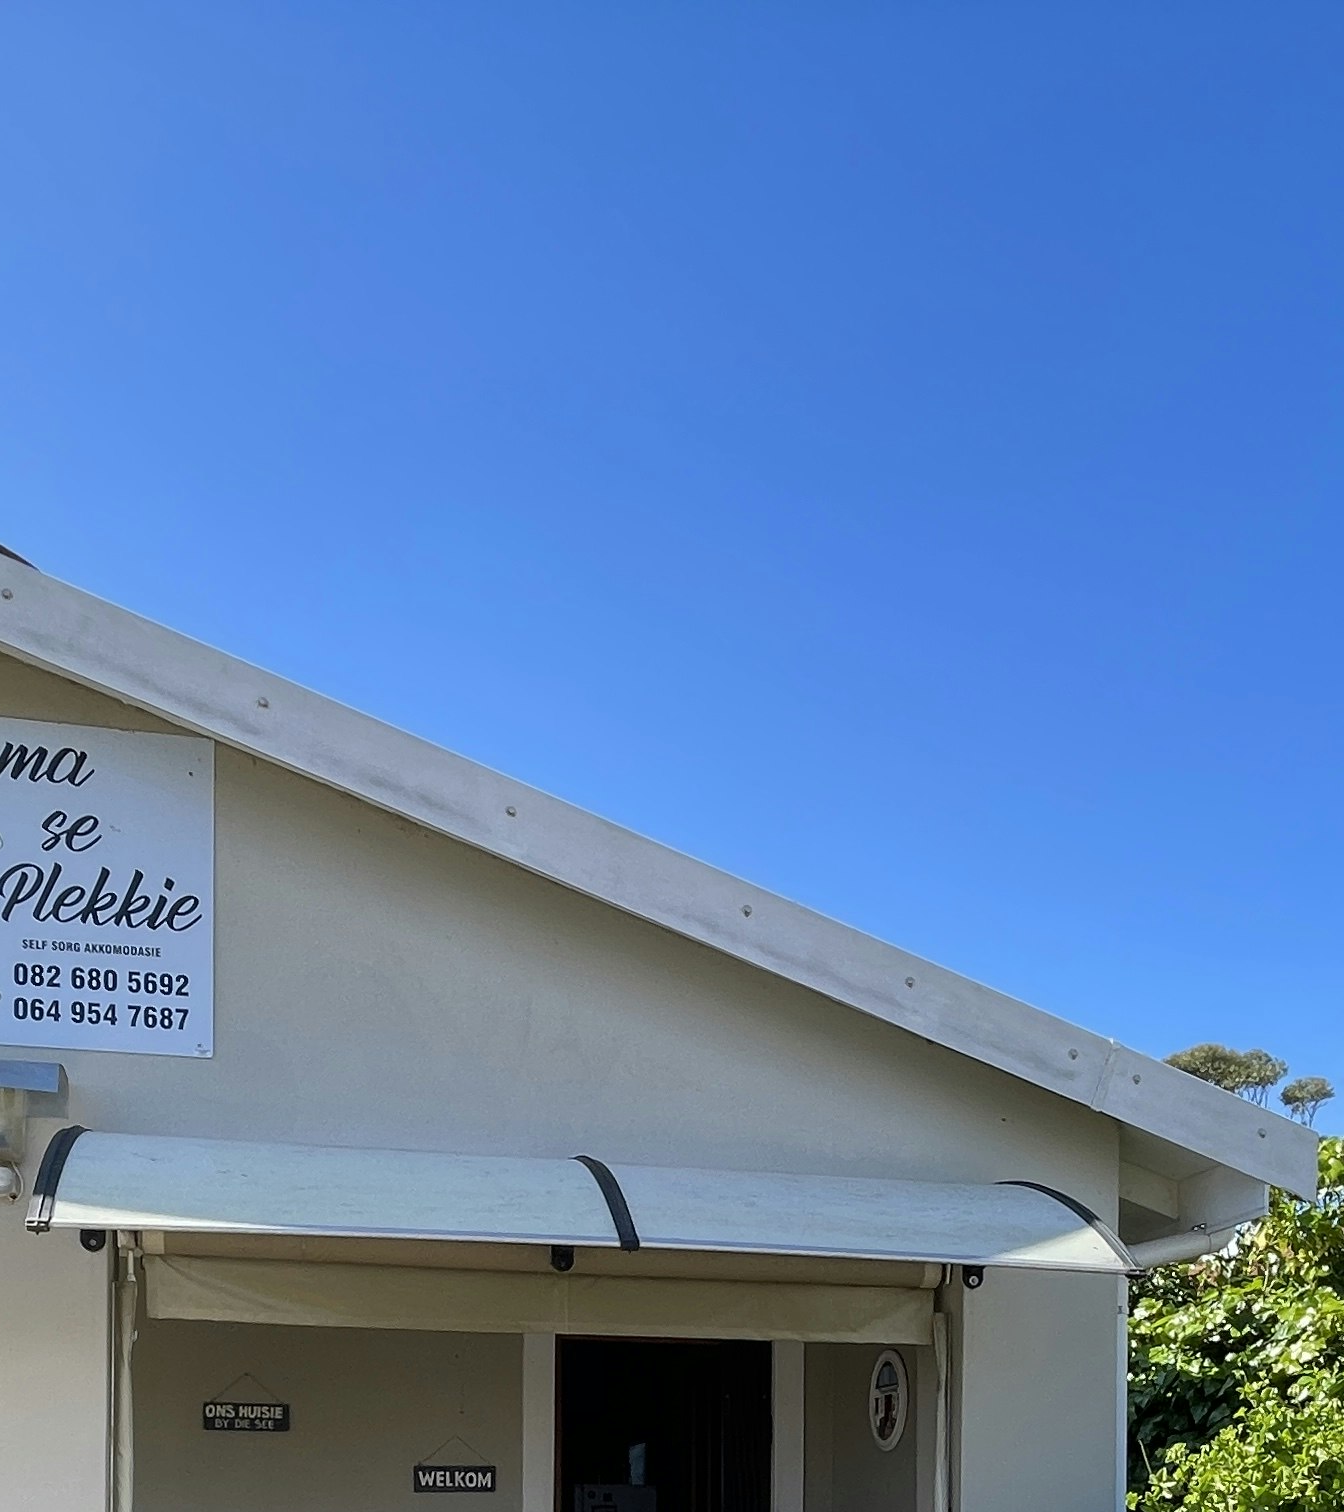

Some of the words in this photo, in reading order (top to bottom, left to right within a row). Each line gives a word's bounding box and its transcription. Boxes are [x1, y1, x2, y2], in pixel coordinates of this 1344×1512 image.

[41, 810, 102, 852] se
[22, 939, 47, 950] SELF
[51, 941, 81, 952] SORG
[84, 943, 162, 957] AKKOMODASIE
[14, 963, 61, 987] 082
[71, 967, 118, 991] 680
[127, 971, 189, 996] 5692
[14, 997, 61, 1022] 064
[71, 1001, 118, 1025] 954
[127, 1005, 189, 1030] 7687
[205, 1404, 235, 1418] ONS
[239, 1405, 283, 1419] HUISIE
[214, 1419, 229, 1428] BY
[235, 1419, 251, 1429] DIE
[418, 1470, 492, 1488] WELKOM
